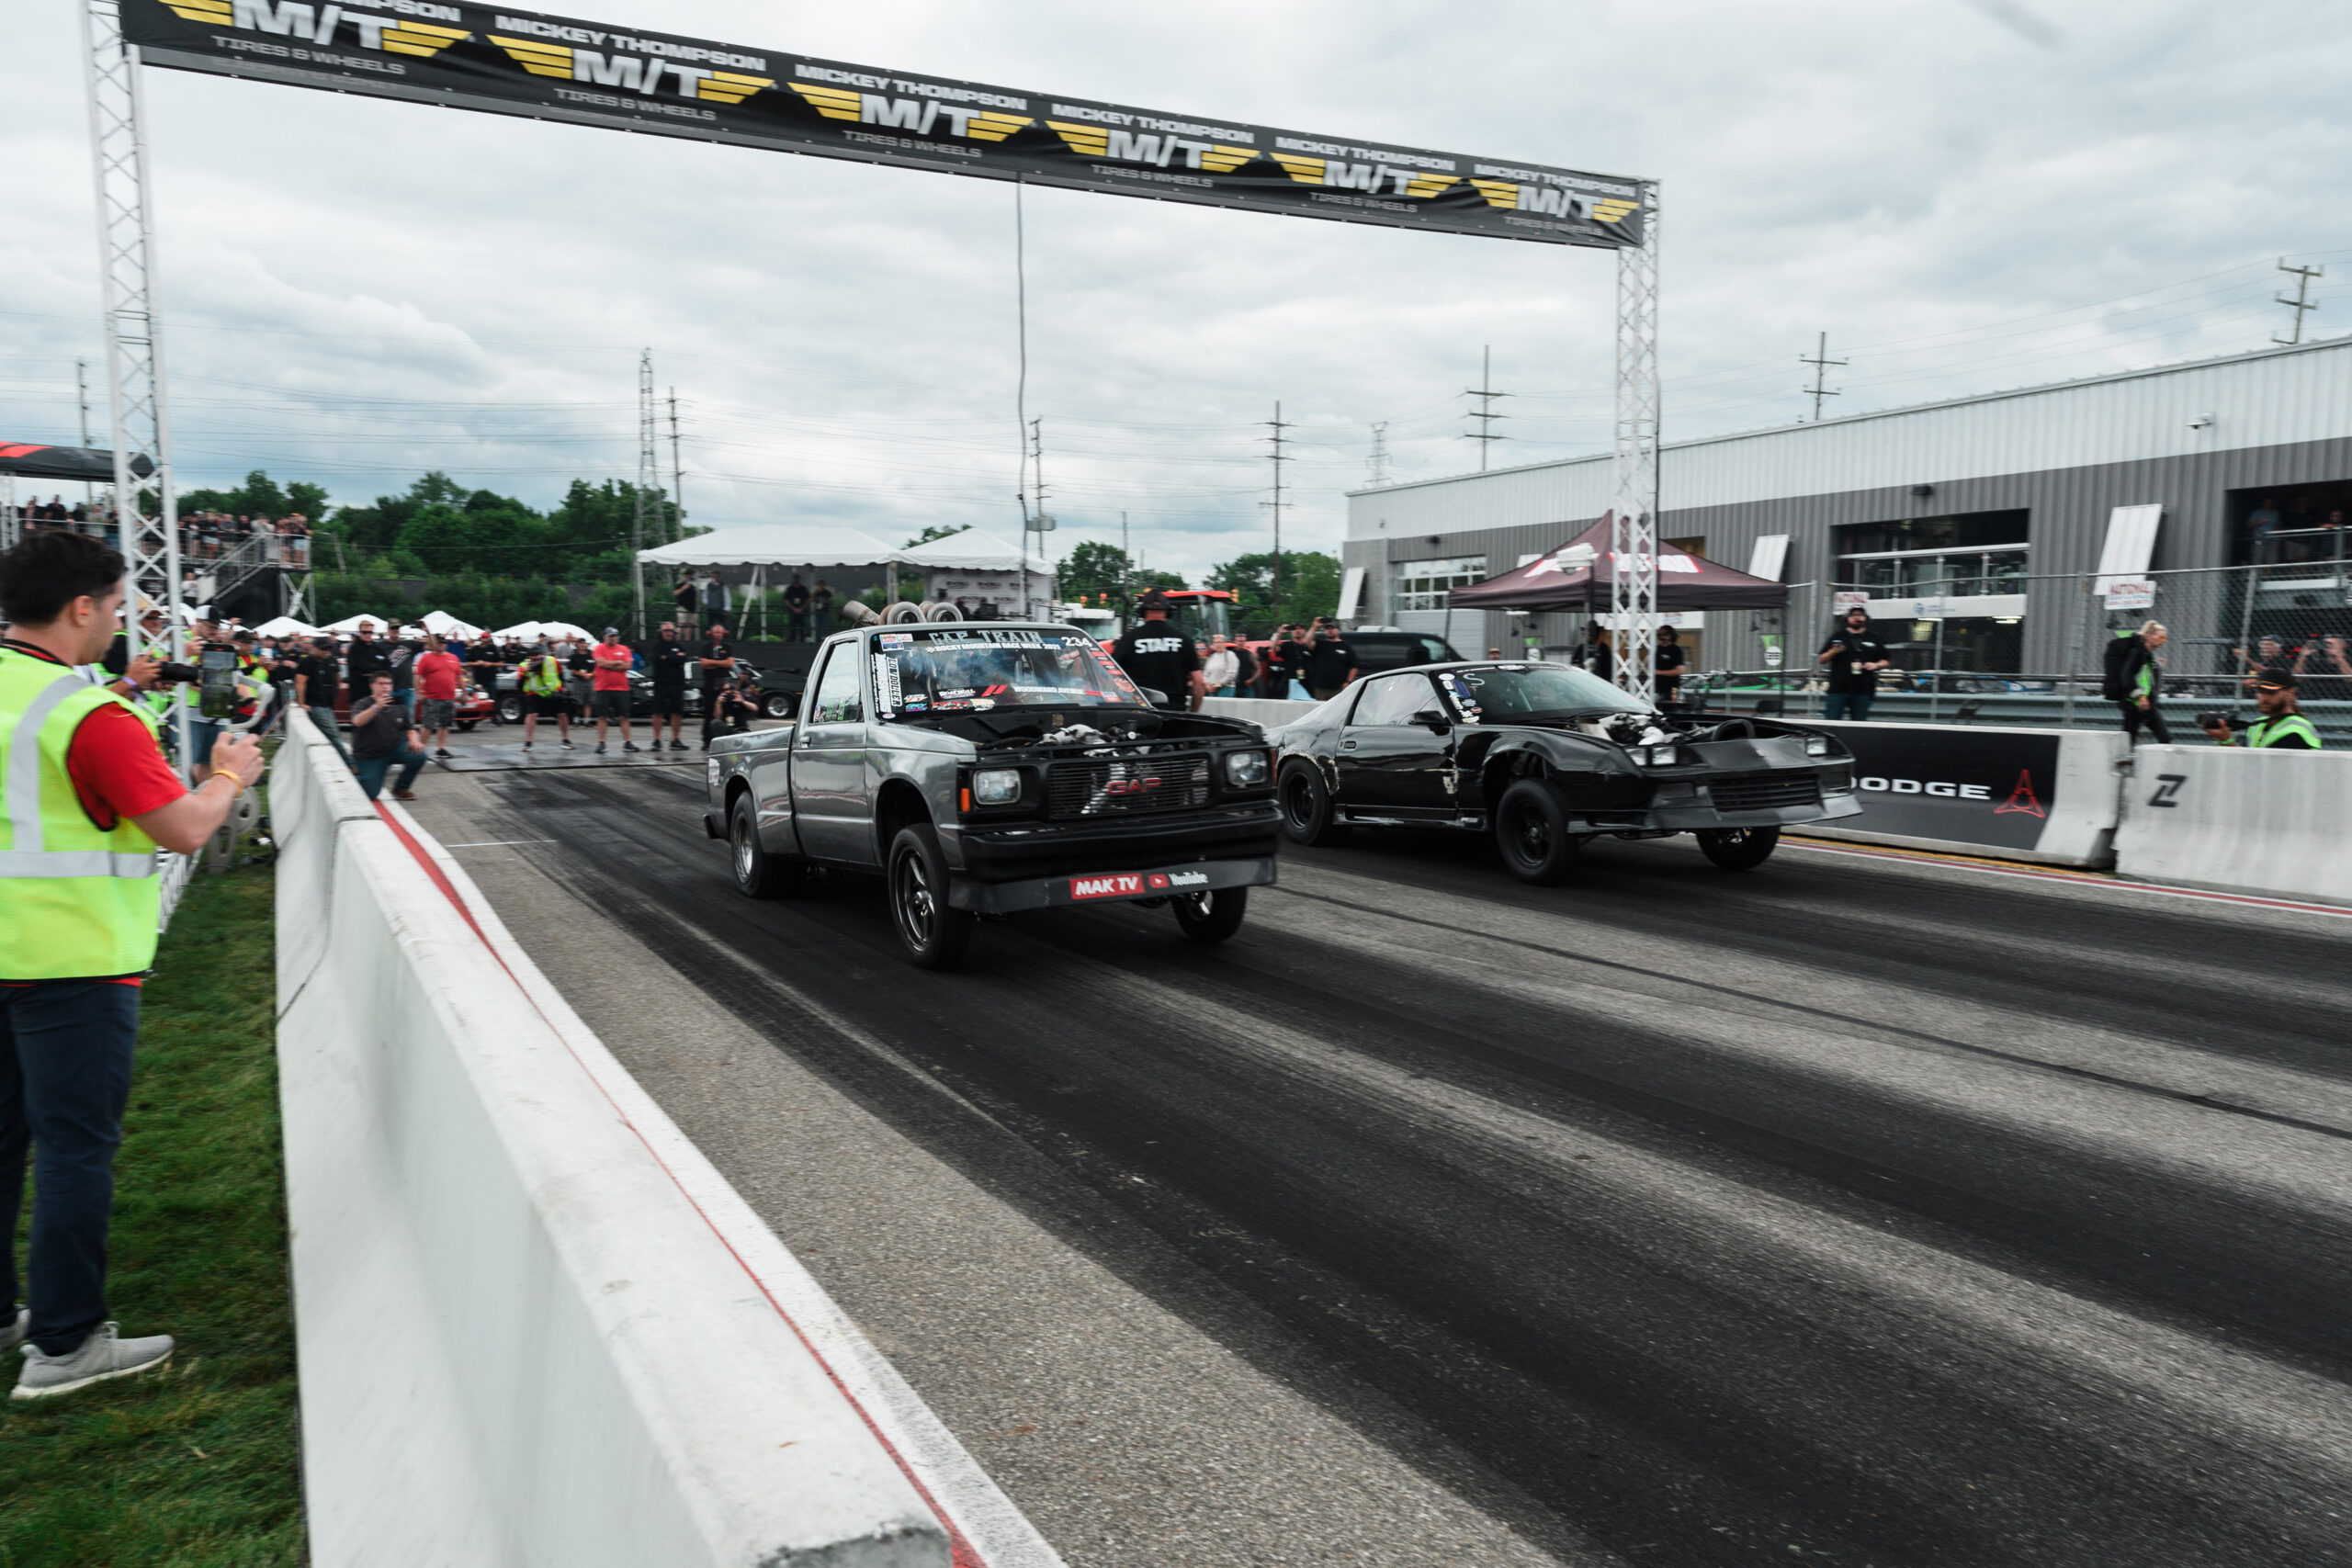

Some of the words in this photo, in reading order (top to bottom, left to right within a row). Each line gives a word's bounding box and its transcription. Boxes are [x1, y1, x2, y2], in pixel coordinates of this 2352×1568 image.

[232, 0, 400, 50] M/T
[210, 35, 289, 57] TIRES
[293, 47, 310, 61] &
[312, 51, 406, 75] WHEELS
[494, 14, 608, 46] MICKEY
[610, 34, 766, 72] THOMPSON
[571, 48, 714, 98] M/T
[795, 63, 891, 90] MICKEY
[892, 79, 1027, 111] THOMPSON
[553, 87, 619, 108] TIRES
[621, 94, 637, 109] &
[638, 99, 717, 121] WHEELS
[860, 93, 982, 137] M/T
[1051, 102, 1136, 126] MICKEY
[1136, 116, 1254, 144] THOMPSON
[842, 130, 898, 147] TIRES
[899, 137, 912, 149] &
[914, 141, 983, 158] WHEELS
[1106, 129, 1215, 170] M/T
[1275, 136, 1350, 157] MICKEY
[1350, 147, 1456, 172] THOMPSON
[1091, 164, 1140, 179] TIRES
[1141, 171, 1152, 180] &
[1153, 173, 1214, 188] WHEELS
[1324, 160, 1419, 196] M/T
[1474, 164, 1541, 181] MICKEY
[1542, 173, 1636, 197] THOMPSON
[1308, 192, 1351, 206] TIRES
[1364, 199, 1418, 213] WHEELS
[1517, 185, 1603, 220] M/T
[977, 629, 1045, 644] TRAIN
[1134, 637, 1183, 655] STAFF
[1108, 777, 1162, 795] GAP
[1850, 775, 1992, 801] ODGE
[1075, 876, 1114, 896] MAK
[1117, 875, 1138, 892] TV
[1168, 871, 1209, 887] YouTube
